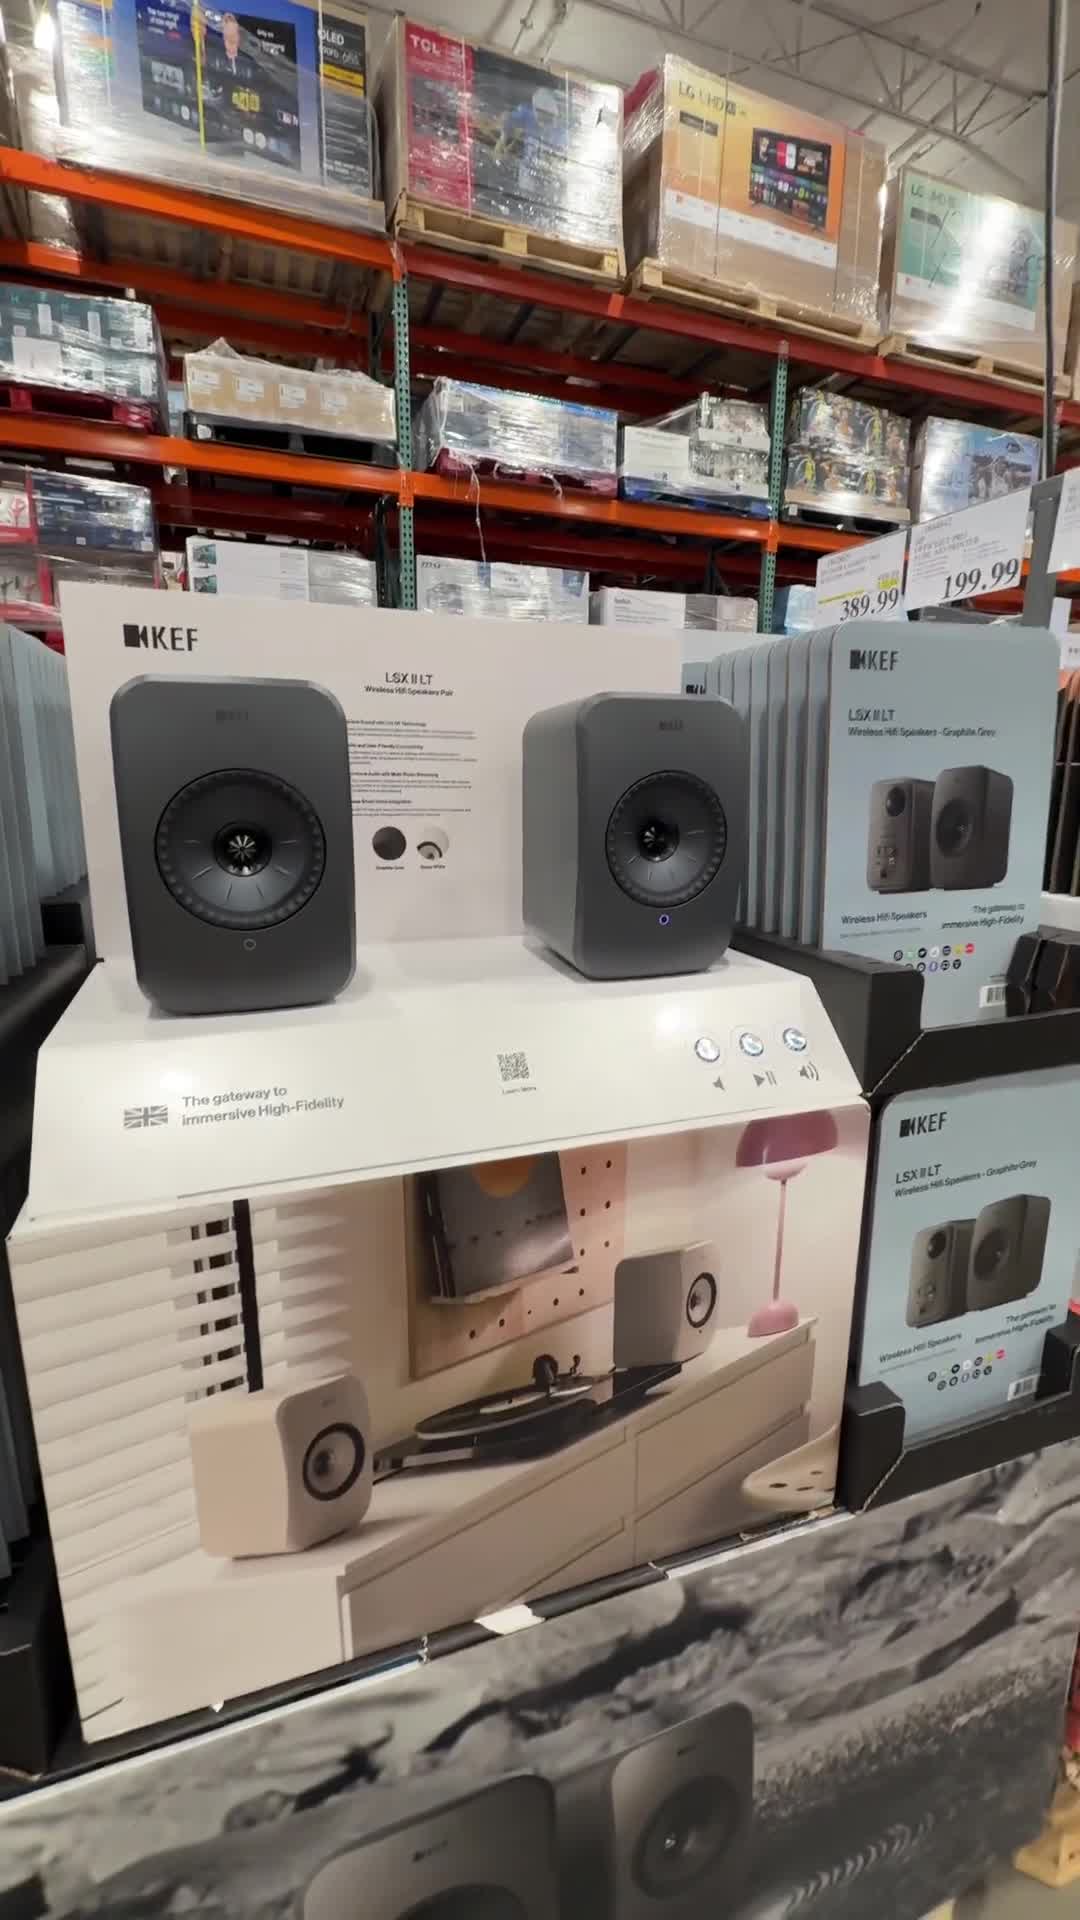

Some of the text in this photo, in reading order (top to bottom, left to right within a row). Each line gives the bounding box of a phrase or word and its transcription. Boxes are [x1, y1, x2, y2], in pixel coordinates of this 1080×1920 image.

[410, 34, 441, 56] TCL
[942, 558, 1019, 599] 199.99
[840, 587, 899, 621] 389.99
[151, 625, 199, 652] KEF
[868, 650, 899, 672] KEF
[385, 671, 409, 684] LSX
[420, 674, 433, 685] LT
[364, 685, 394, 695] Wireless
[407, 687, 439, 697] Speakers
[440, 688, 454, 697] Pair
[848, 708, 871, 722] LSX
[881, 708, 895, 722] LT
[848, 726, 883, 737] Wireless
[899, 727, 937, 739] Speakers
[841, 914, 876, 925] Wireless
[891, 910, 928, 923] Speakers
[973, 904, 987, 914] The
[941, 915, 1025, 930] immersive High-Fidelity
[182, 1086, 288, 1108] The gateway to
[182, 1097, 345, 1127] immersive High-Fidelity
[916, 1112, 947, 1134] KEF
[895, 1168, 918, 1185] LSX
[927, 1163, 942, 1177] LT
[895, 1184, 929, 1198] Wireless
[944, 1171, 981, 1187] Speakers
[986, 1163, 1017, 1178] Graphite
[1018, 1159, 1038, 1172] Grey
[879, 1349, 912, 1364] Wireless
[927, 1333, 962, 1349] Speakers
